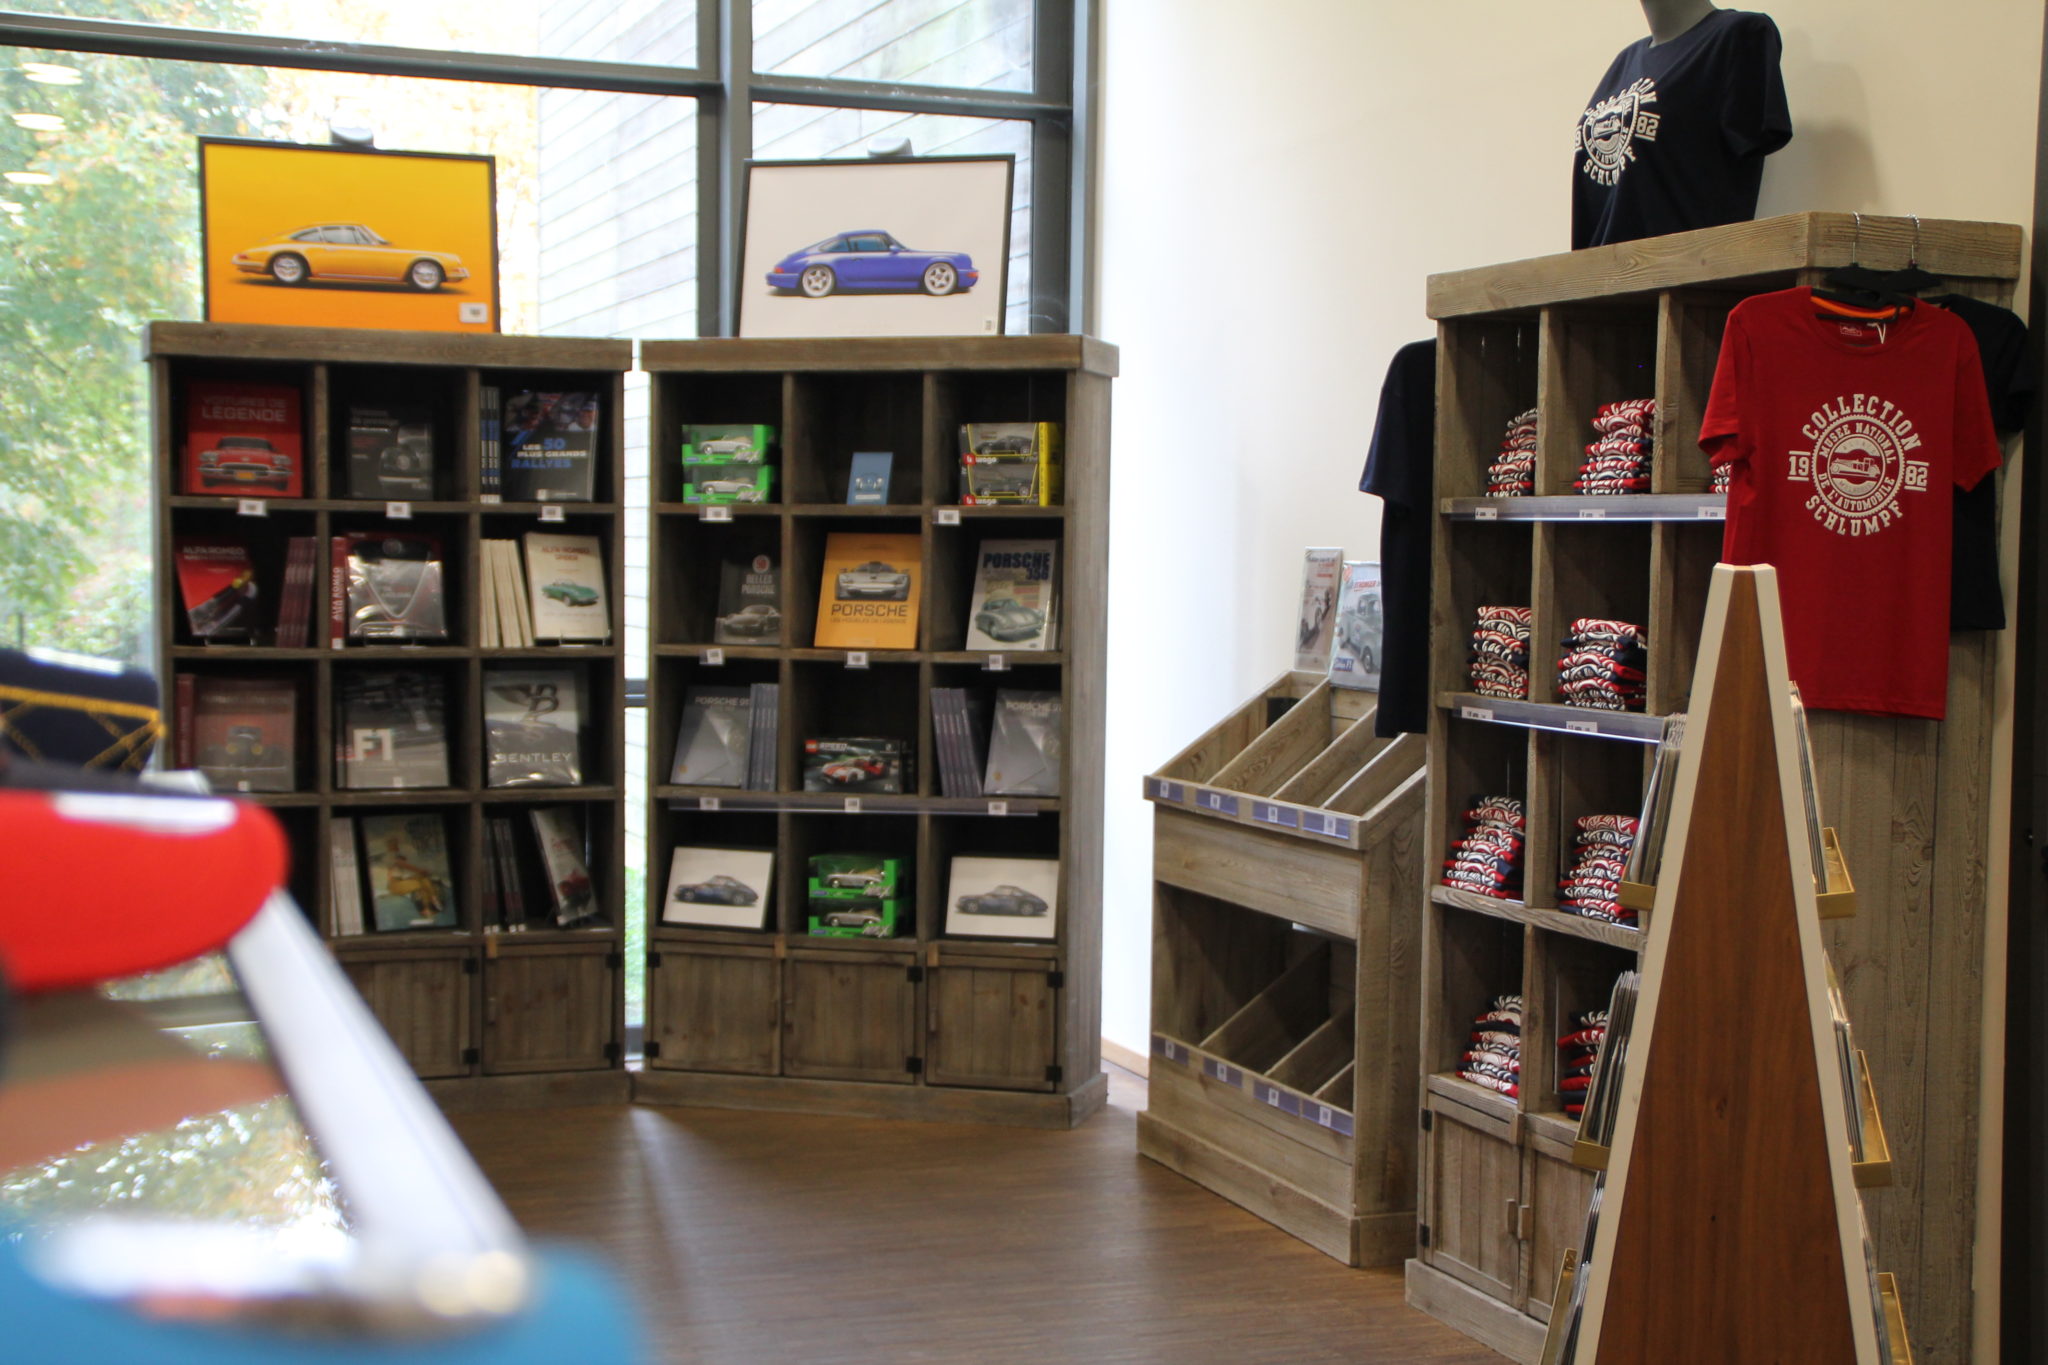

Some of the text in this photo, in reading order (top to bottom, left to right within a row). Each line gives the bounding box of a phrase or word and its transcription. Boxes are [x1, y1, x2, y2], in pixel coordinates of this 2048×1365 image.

[1636, 115, 1659, 137] 82
[201, 405, 287, 422] LEGENDE
[1802, 393, 1921, 452] COLLECTION
[543, 437, 566, 450] 50
[1819, 424, 1851, 458] MUSEE
[1855, 422, 1897, 464] NATIONAL
[544, 450, 588, 458] GRANDS
[511, 459, 572, 469] RALLYES
[1788, 456, 1928, 487] 19 82
[1818, 472, 1830, 489] DE
[1827, 476, 1895, 512] L'AUTOMOBILE
[1805, 494, 1903, 537] SCHLUMPF
[983, 552, 1051, 568] PORSCHE
[831, 603, 909, 617] PORSCHE
[695, 696, 739, 706] PORSCHE
[353, 727, 393, 761] F1
[495, 752, 572, 763] BENTLEY
